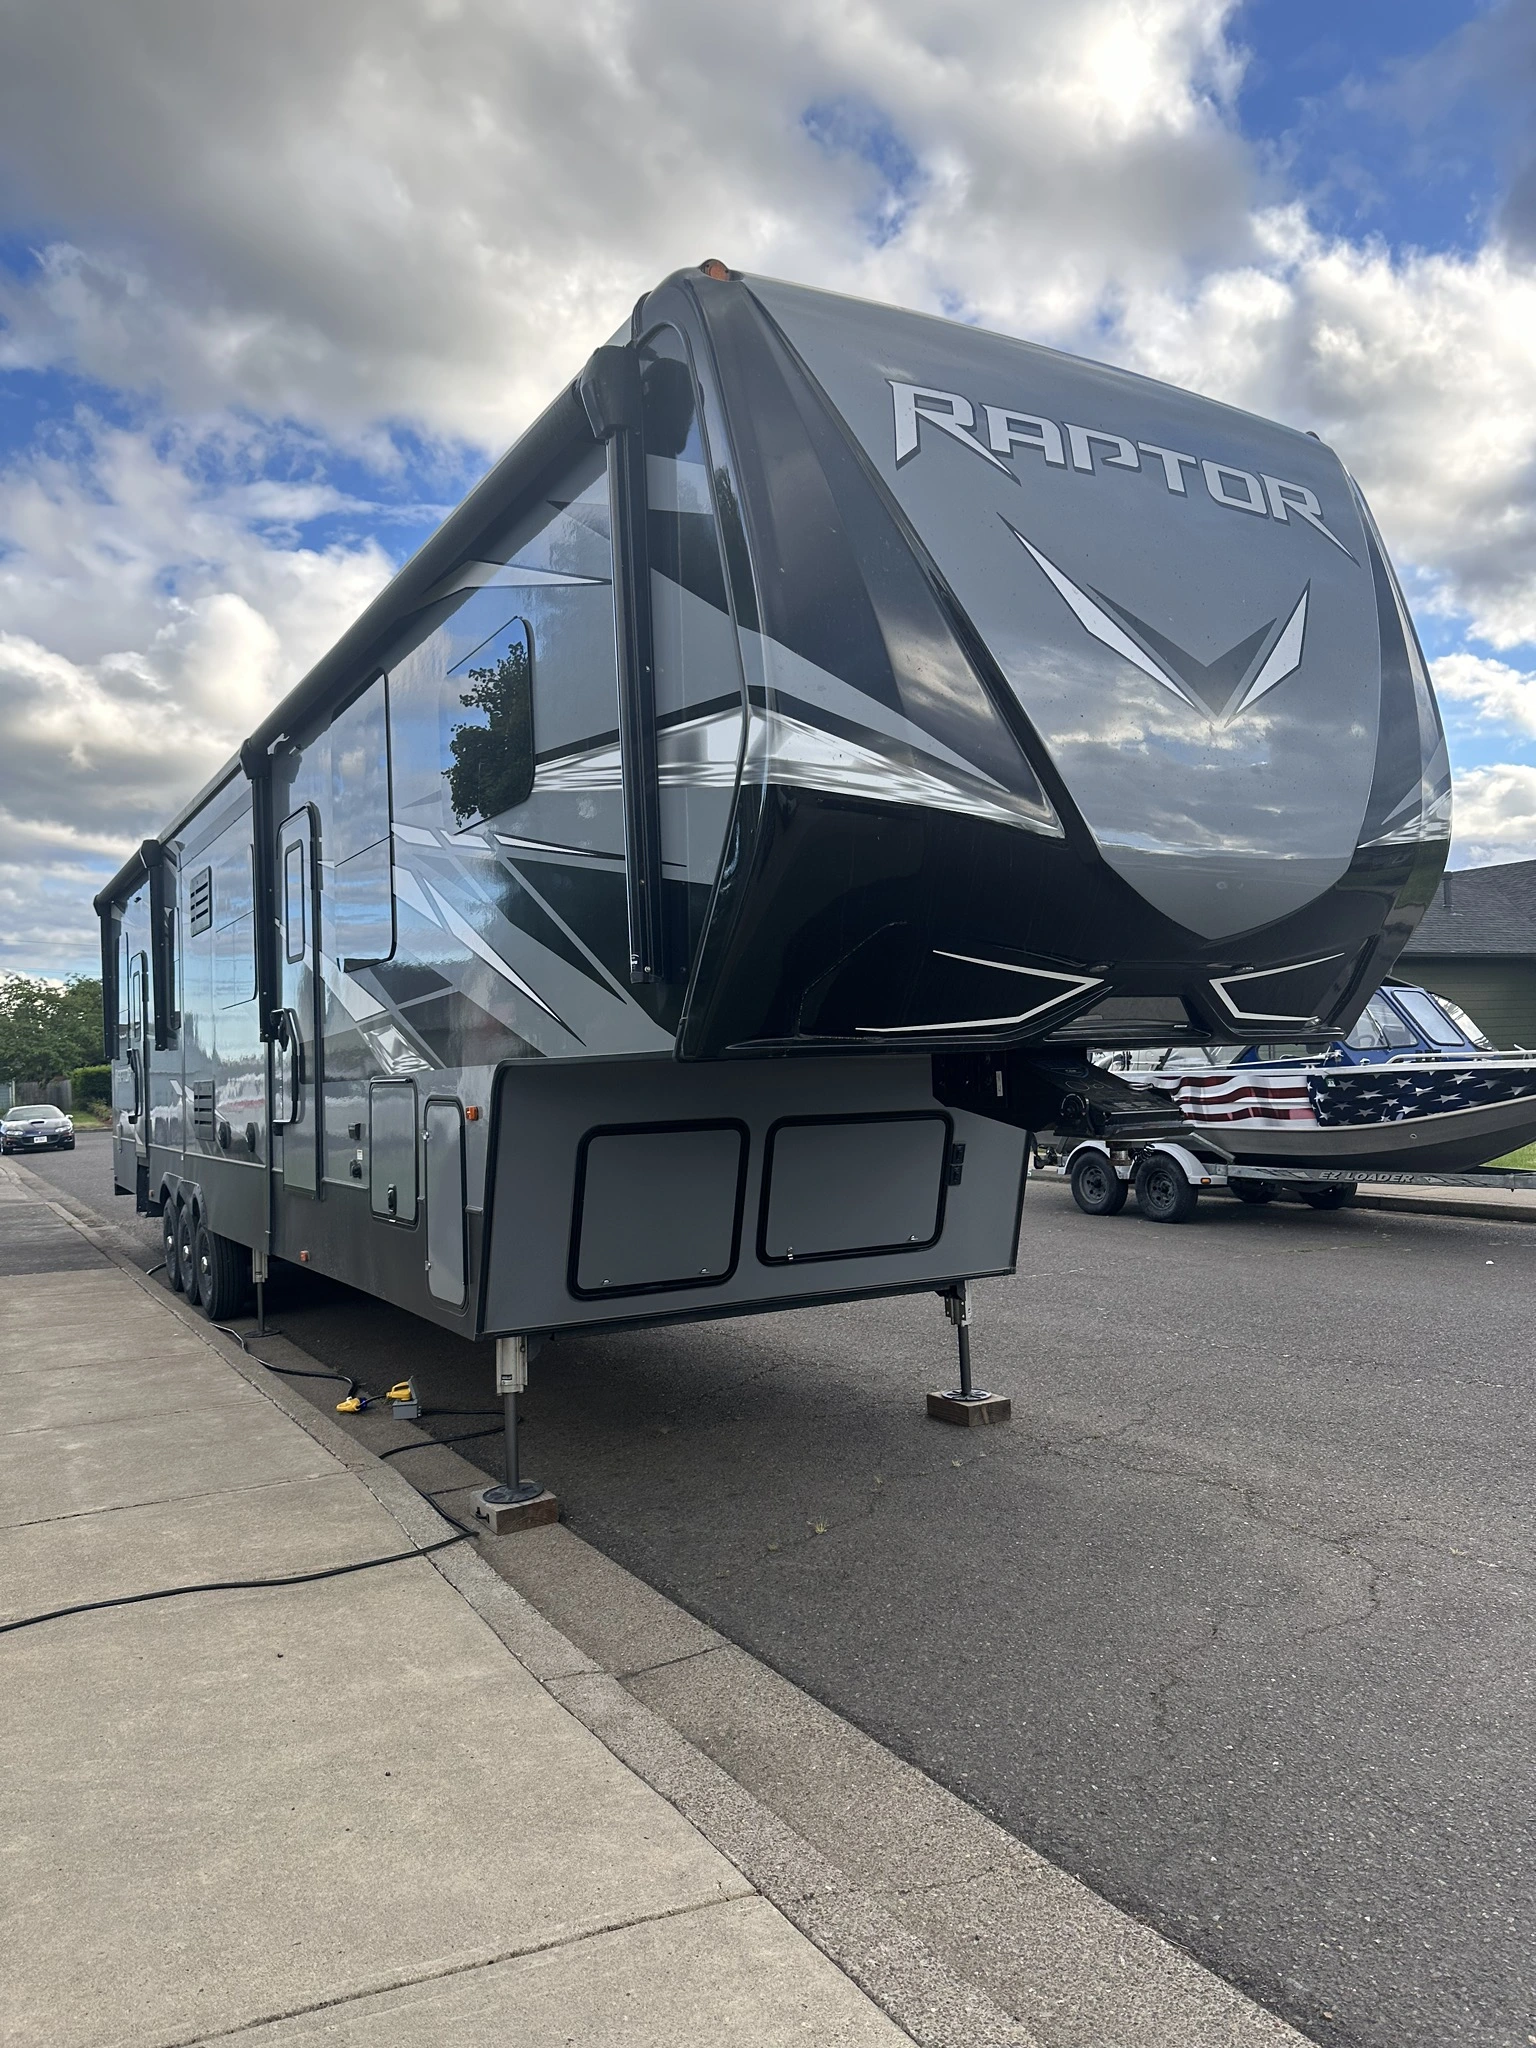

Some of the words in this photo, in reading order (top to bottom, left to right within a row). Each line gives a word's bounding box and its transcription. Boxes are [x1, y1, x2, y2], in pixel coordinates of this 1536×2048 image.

[886, 379, 1360, 566] RAPTOR
[1318, 1171, 1341, 1180] EZ
[1344, 1172, 1415, 1183] LOADER
